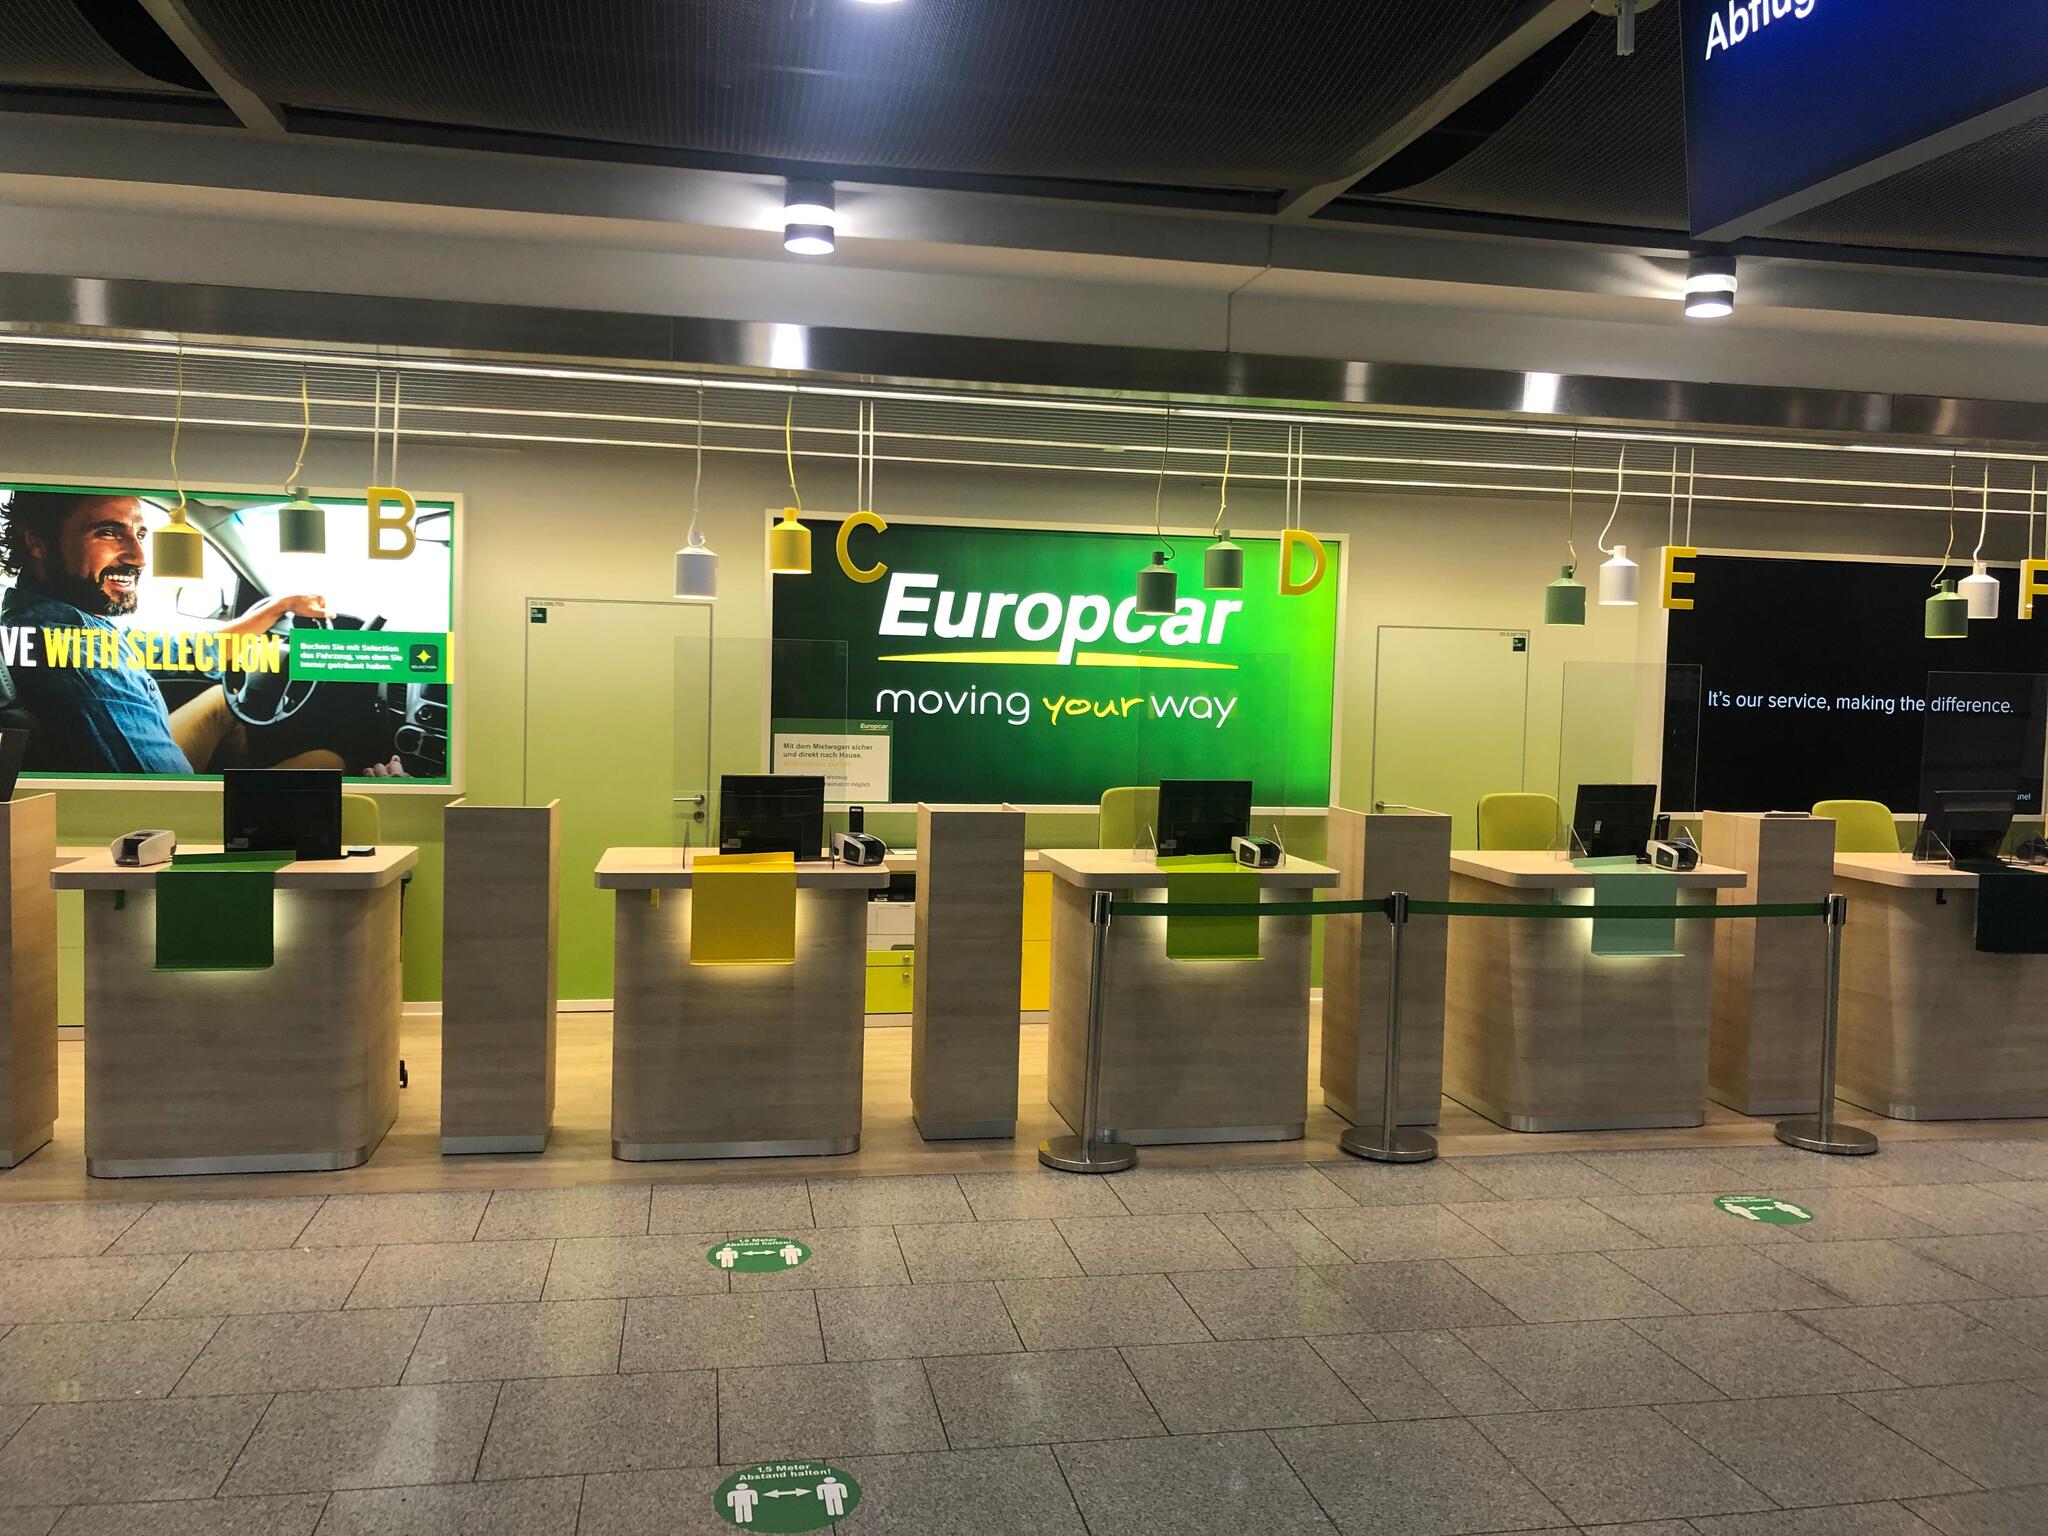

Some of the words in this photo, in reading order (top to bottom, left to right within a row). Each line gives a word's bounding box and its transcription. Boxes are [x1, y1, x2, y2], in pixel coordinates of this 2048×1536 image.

[367, 487, 416, 560] B
[836, 511, 888, 584] C
[1278, 529, 1327, 596] D
[1661, 546, 1698, 610] E
[2018, 559, 2048, 620] F
[878, 572, 1243, 666] Europcar
[0, 626, 37, 668] VE
[42, 627, 119, 669] WITH
[127, 628, 281, 674] SELECTION
[332, 643, 345, 651] Sie
[346, 644, 360, 652] mit
[361, 644, 399, 653] Selection
[390, 654, 403, 662] Sie
[875, 684, 1031, 726] moving
[1042, 692, 1145, 726] your
[1150, 694, 1238, 729] way
[1708, 690, 1731, 707] It's
[1736, 696, 1763, 708] our
[1768, 693, 1831, 711] service,
[1836, 694, 1895, 714] making
[1900, 695, 1926, 712] the
[1931, 696, 2014, 713] difference.
[813, 743, 850, 752] Mietwagen
[860, 722, 888, 731] Europcar
[739, 1471, 787, 1481] Abstand
[790, 1468, 832, 1478] halten!
[776, 1464, 811, 1472] Meter
